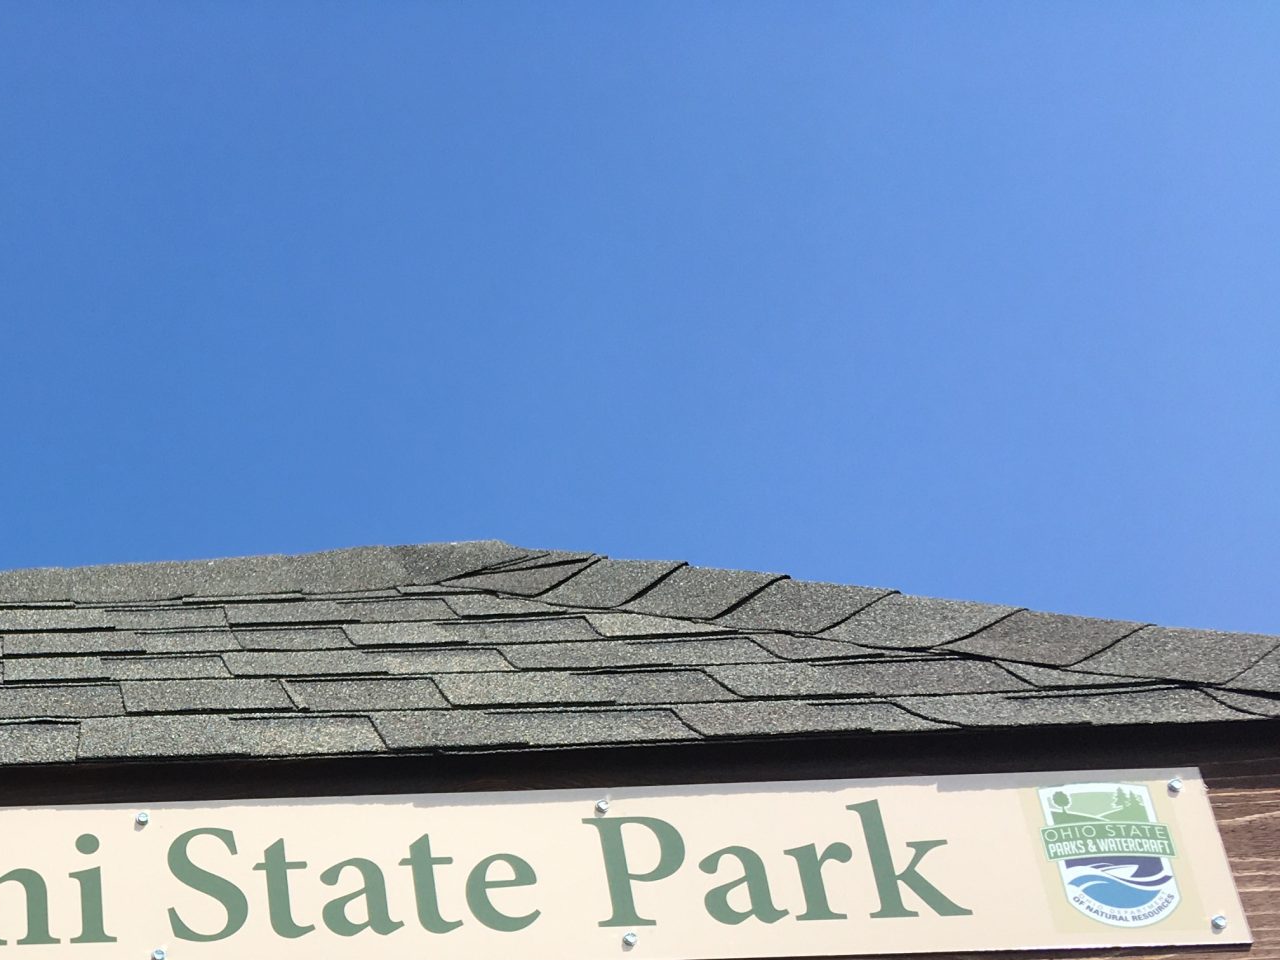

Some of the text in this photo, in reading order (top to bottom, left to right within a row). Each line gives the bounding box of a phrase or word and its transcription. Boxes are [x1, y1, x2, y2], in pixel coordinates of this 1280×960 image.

[1044, 825, 1167, 842] OHIO STATE
[1048, 838, 1170, 857] PARKS & WATERCRAFT
[167, 827, 541, 942] State
[581, 799, 973, 927] Park
[1073, 893, 1175, 922] OF NATURAL RESOURCES
